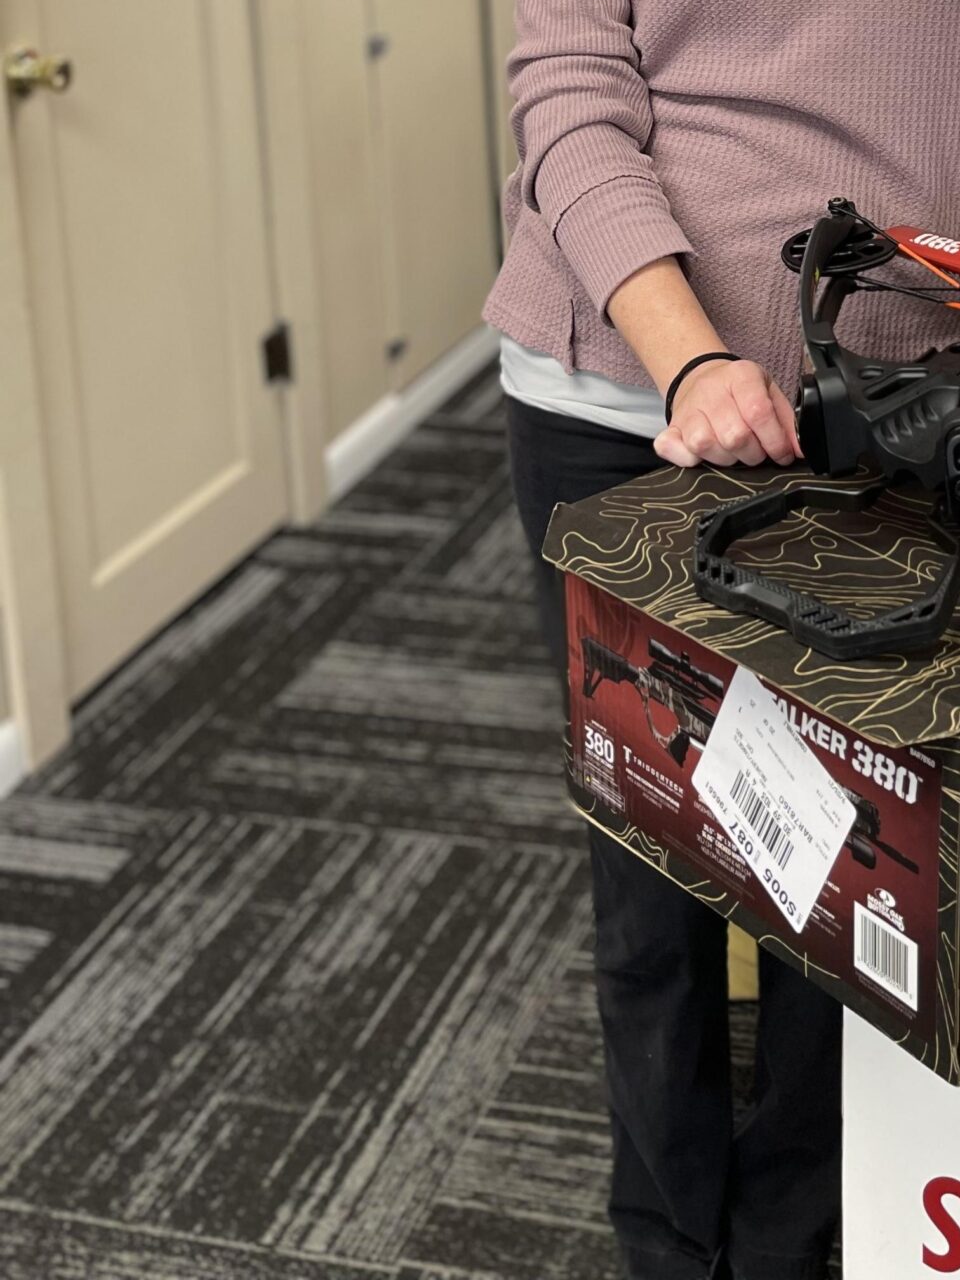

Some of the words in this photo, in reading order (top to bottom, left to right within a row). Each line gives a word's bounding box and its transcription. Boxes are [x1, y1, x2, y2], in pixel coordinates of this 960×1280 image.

[584, 724, 615, 764] 380
[771, 694, 848, 760] ALKER
[852, 740, 919, 804] 380
[633, 756, 684, 795] TRIGGERTECH
[728, 821, 754, 856] 087
[778, 795, 813, 844] BAR78160
[763, 868, 797, 917] S005
[867, 893, 889, 914] MOSSY
